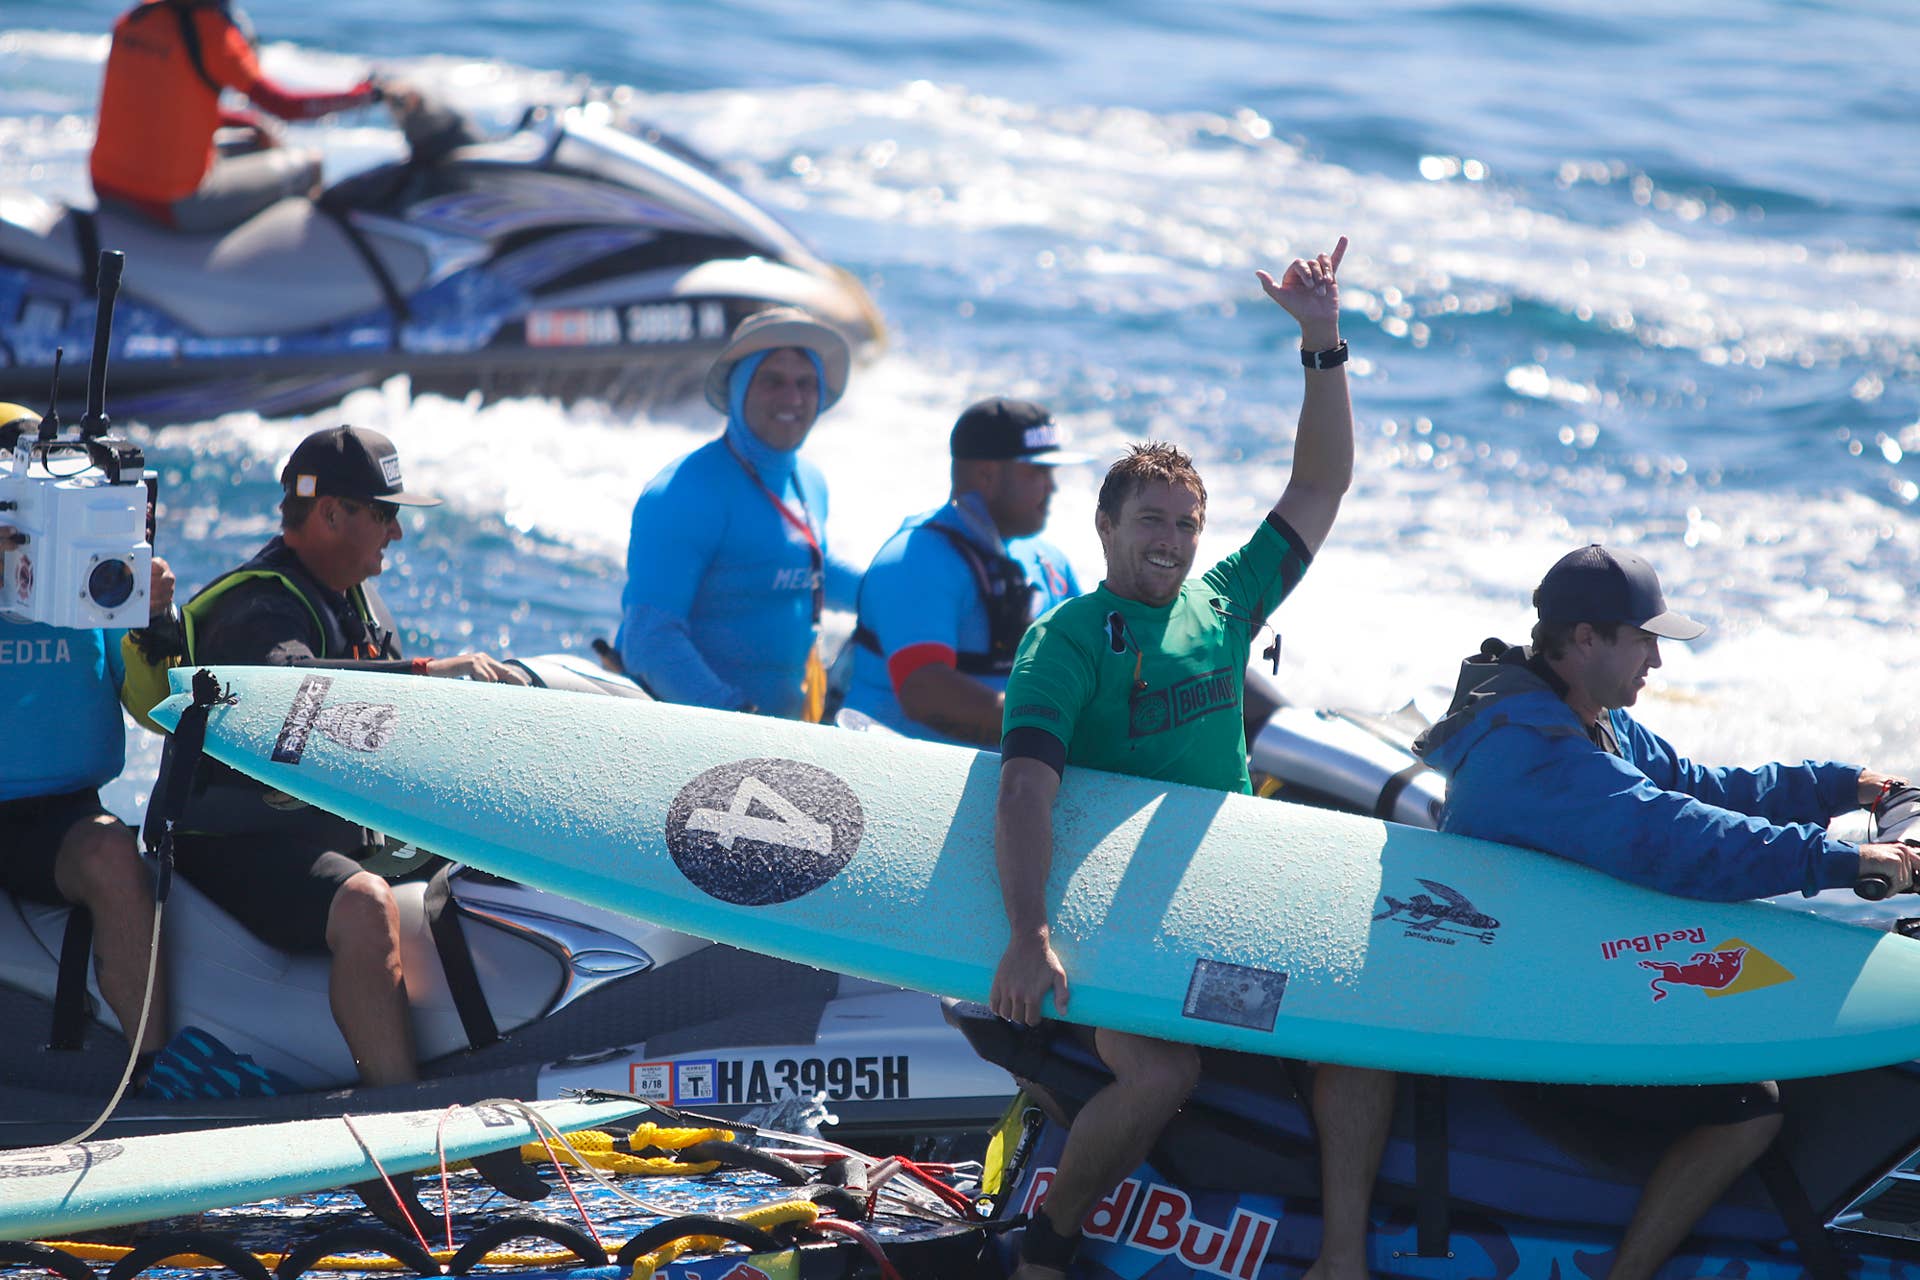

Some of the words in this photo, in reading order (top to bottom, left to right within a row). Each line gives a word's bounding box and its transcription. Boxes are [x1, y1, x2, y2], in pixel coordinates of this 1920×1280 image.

[1180, 681, 1208, 716] BIG
[685, 776, 833, 858] 4
[1404, 930, 1456, 946] patagonia
[1600, 936, 1653, 961] Bull
[1654, 927, 1708, 952] Red
[642, 1079, 662, 1090] 8/18
[688, 1077, 704, 1097] T
[718, 1056, 909, 1103] HA3995H
[1020, 1167, 1142, 1244] Rd
[1126, 1182, 1279, 1280] Bull
